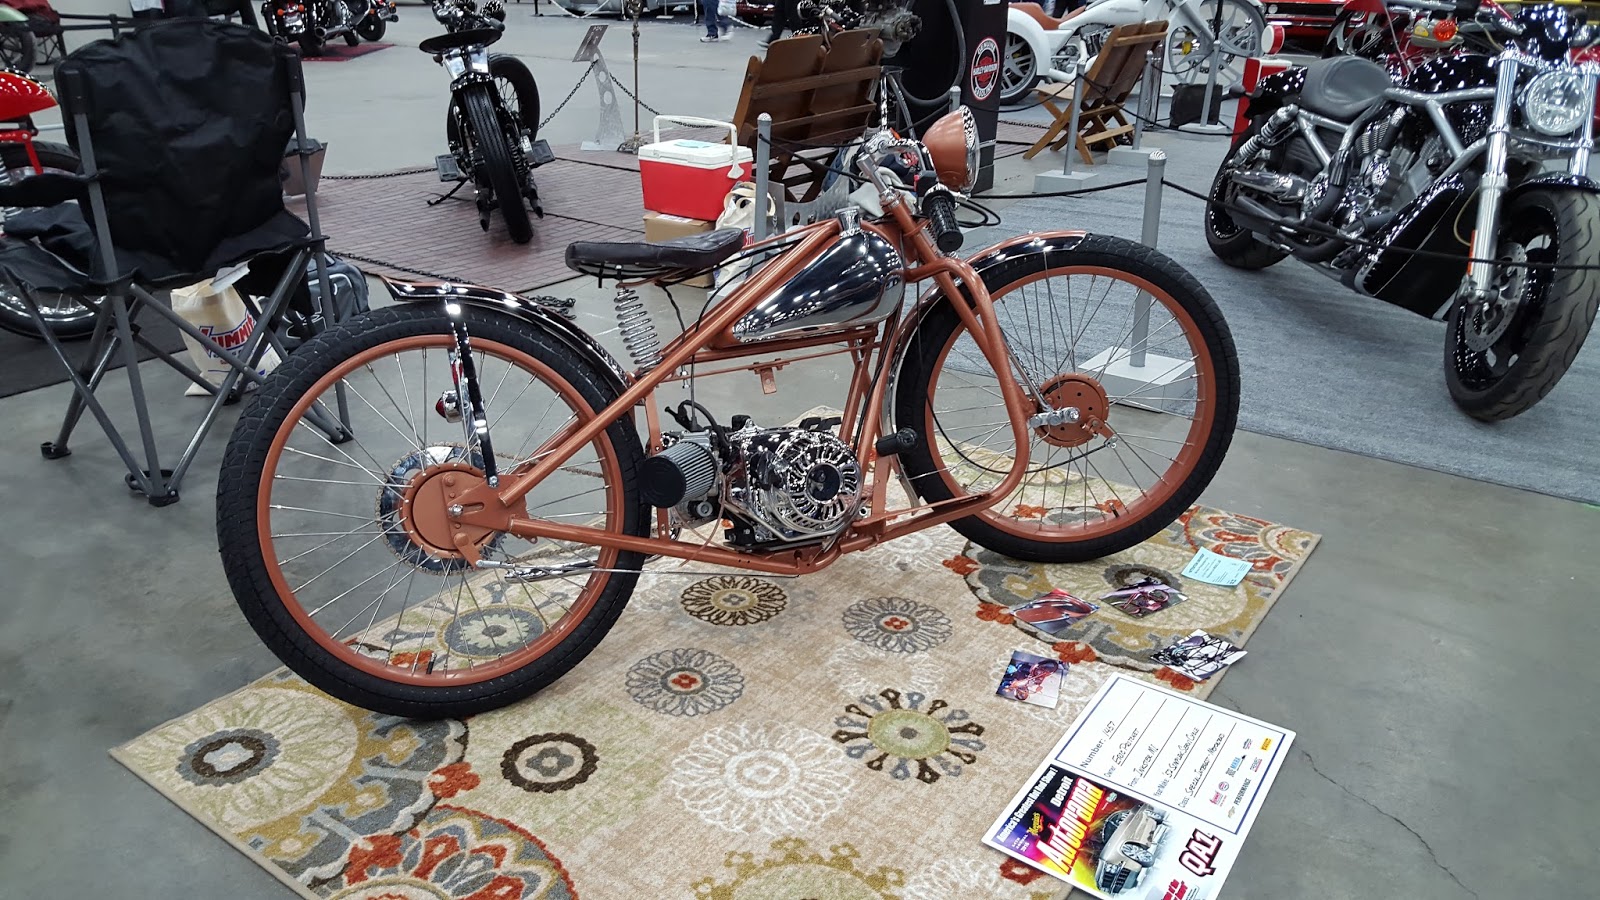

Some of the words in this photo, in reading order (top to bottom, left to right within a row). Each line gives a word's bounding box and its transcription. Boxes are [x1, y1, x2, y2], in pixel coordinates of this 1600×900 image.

[1080, 738, 1106, 768] Number:
[1050, 775, 1073, 807] Detroit
[996, 817, 1020, 842] America's
[1014, 797, 1035, 819] Greatest
[1036, 776, 1104, 875] Autorama
[1178, 828, 1223, 877] QA1
